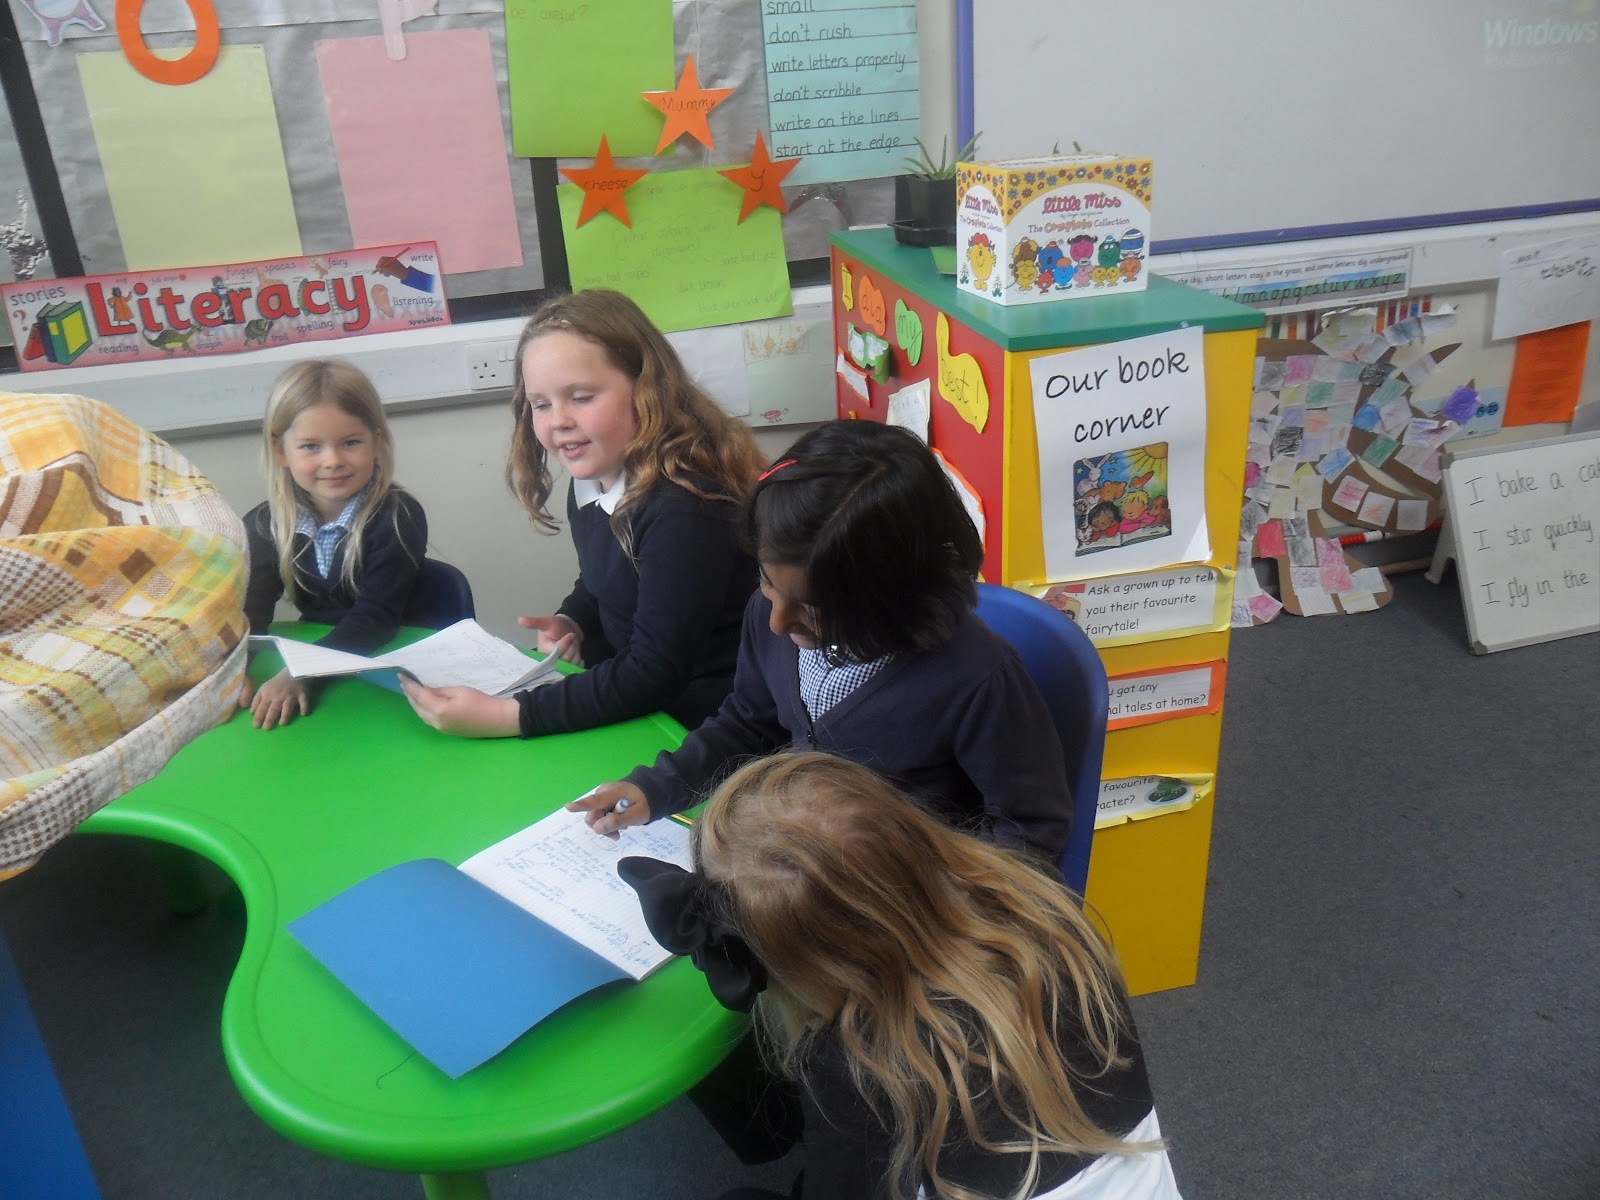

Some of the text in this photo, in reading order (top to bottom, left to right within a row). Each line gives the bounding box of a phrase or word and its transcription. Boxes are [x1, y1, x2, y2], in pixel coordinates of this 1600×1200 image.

[767, 0, 815, 15] small
[769, 22, 852, 44] don't rush
[1484, 17, 1599, 48] Windows
[771, 50, 906, 73] write letters properly
[774, 82, 862, 102] don't scribble
[662, 97, 717, 112] Mummy
[775, 109, 899, 131] write on the lines
[775, 133, 900, 157] start at the edge
[583, 178, 629, 190] cheese
[1083, 192, 1122, 209] Miss
[1028, 217, 1131, 233] The Complete Collection
[327, 257, 348, 269] fairy
[410, 253, 434, 262] write
[1205, 274, 1223, 282] short
[1249, 272, 1264, 280] stay
[1357, 258, 1367, 267] dig
[10, 286, 67, 306] stories
[85, 275, 371, 336] Literacy
[392, 296, 434, 307] listening
[296, 320, 334, 335] spelling
[99, 342, 140, 355] reading
[1045, 347, 1190, 398] Our book
[1073, 405, 1170, 443] corner
[1464, 476, 1485, 506] I
[1496, 472, 1538, 498] bake
[1550, 472, 1565, 489] a
[1472, 529, 1491, 551] I
[1544, 513, 1594, 551] quickly
[1088, 570, 1214, 596] Ask a grown up to tell
[1481, 569, 1590, 608] I fly in the
[1086, 593, 1196, 618] you their favourite
[1084, 618, 1140, 637] fairytale!
[1116, 684, 1135, 698] got
[1139, 683, 1159, 693] any
[1125, 701, 1152, 713] tales
[1155, 700, 1168, 709] at
[1171, 693, 1206, 707] home?
[1103, 777, 1154, 793] favourite
